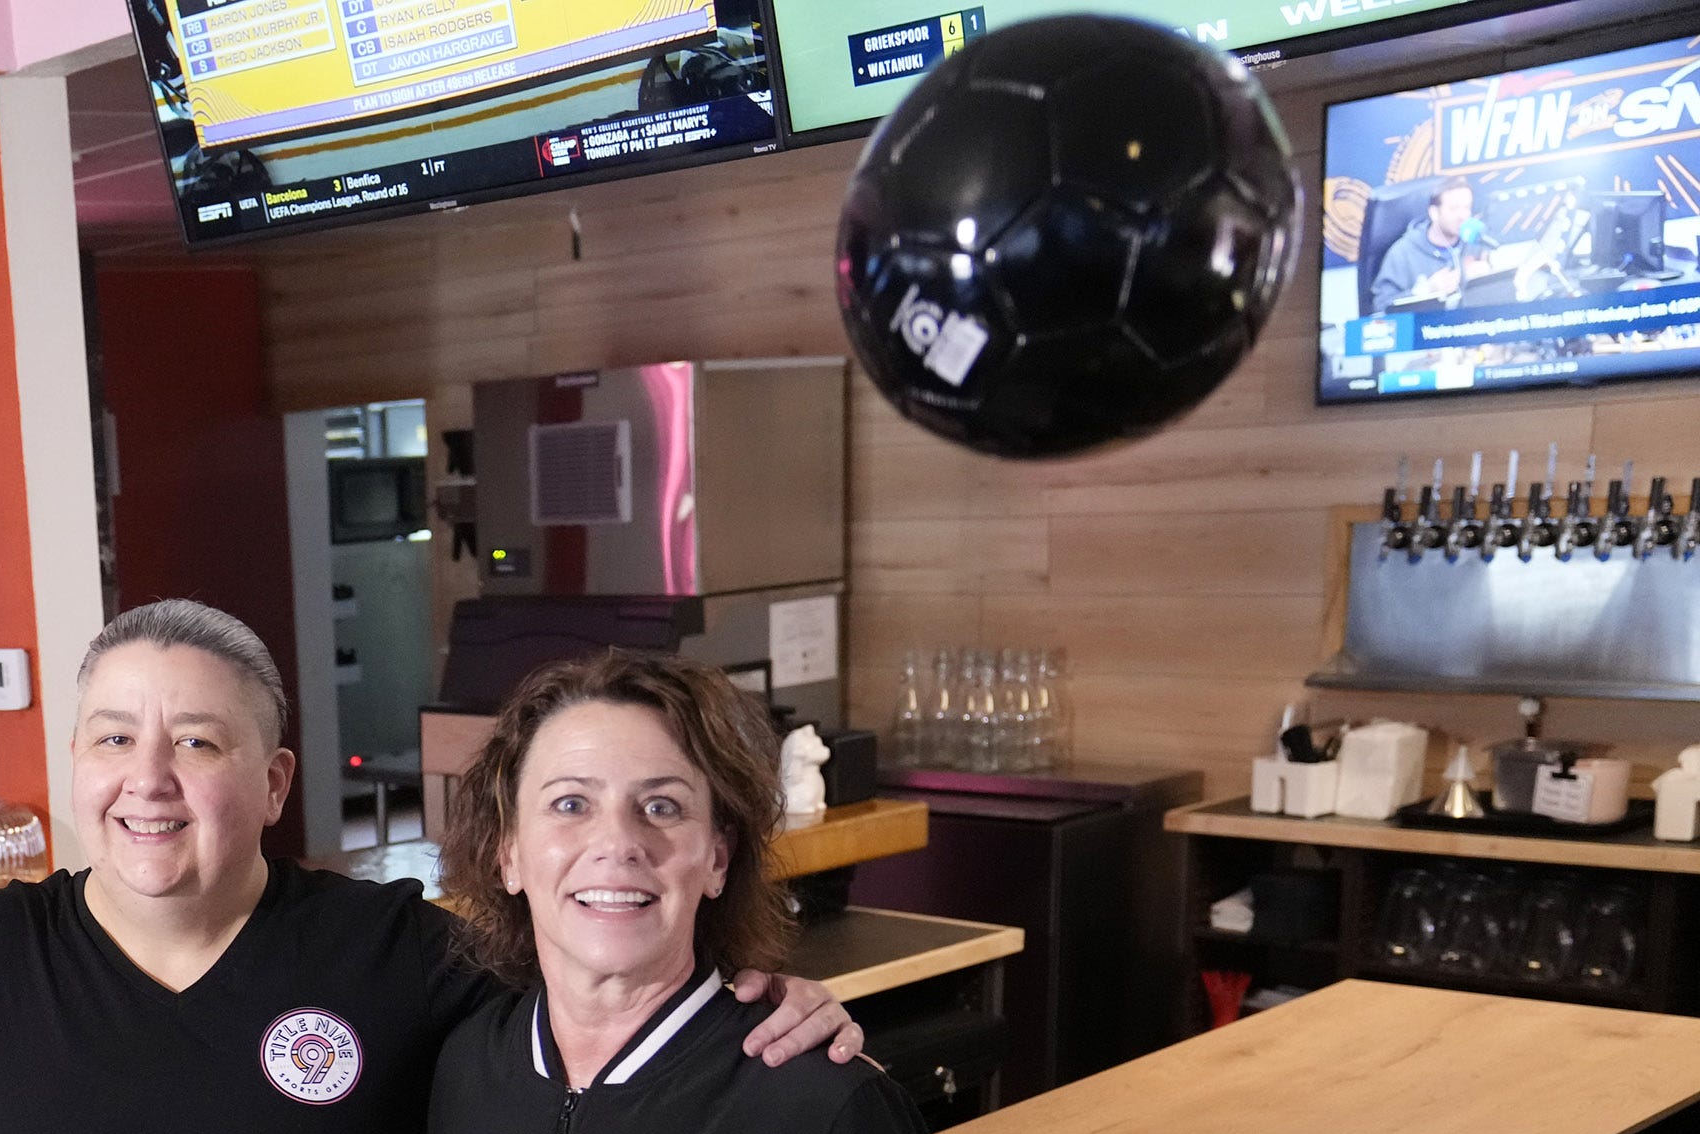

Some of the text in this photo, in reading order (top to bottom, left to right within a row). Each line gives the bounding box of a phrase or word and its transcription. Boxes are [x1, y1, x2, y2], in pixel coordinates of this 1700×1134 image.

[187, 0, 287, 35] RB AARON JONES
[356, 0, 457, 34] C RYAN KELLY
[357, 11, 493, 56] CB ISAIAH RODGERS
[864, 14, 978, 53] GRIEKSPOOR 6 1
[191, 41, 207, 54] CB
[214, 32, 251, 49] BYRON
[253, 18, 299, 38] MURPHY
[199, 37, 302, 72] S THEO JACKSON
[362, 31, 505, 76] DT JAVON HARGRAVE
[867, 52, 924, 78] WATANUKI
[353, 61, 517, 111] PLAN TO SIGN AFTER 49ERS RELEASE
[589, 130, 630, 148] GONZAGA
[645, 120, 673, 137] SAINT
[673, 114, 709, 132] MARY'S
[621, 115, 653, 129] BASKETBALL
[668, 105, 710, 121] CHAMPIONSHIP
[1450, 77, 1573, 165] WFAN
[1613, 82, 1700, 138] SN
[584, 144, 621, 161] TONIGHT
[622, 142, 629, 154] 9
[629, 139, 644, 153] PM
[645, 137, 658, 150] ET
[346, 162, 429, 190] Benfica 1
[433, 160, 446, 173] FT
[238, 197, 259, 211] UEFA
[266, 179, 342, 206] Barcelona 3
[269, 203, 291, 219] UEFA
[290, 198, 332, 217] Champions
[362, 187, 387, 203] Round
[387, 185, 397, 198] of
[397, 182, 409, 197] 16
[197, 202, 234, 223] ESPN
[270, 1017, 354, 1062] TITLE NINE
[280, 1071, 350, 1095] SPORTS GRILL
